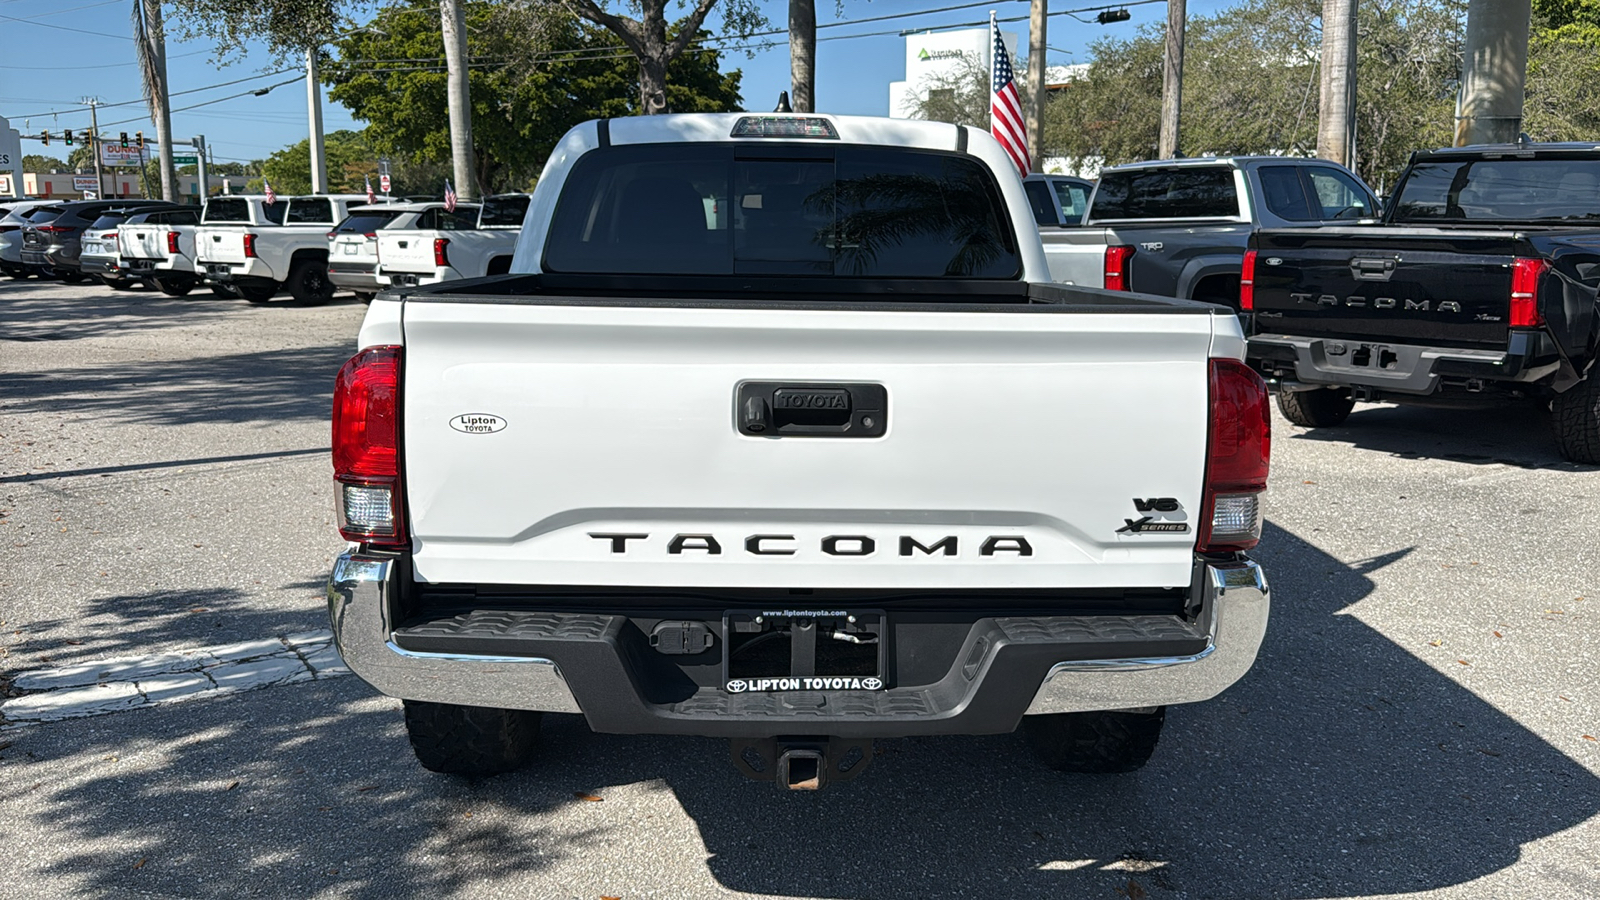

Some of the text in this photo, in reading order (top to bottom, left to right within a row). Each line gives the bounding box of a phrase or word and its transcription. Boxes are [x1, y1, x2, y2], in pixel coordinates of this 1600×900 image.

[1140, 241, 1163, 251] TRD
[1290, 293, 1461, 313] TACOMA
[781, 394, 846, 408] TOYOTA
[461, 416, 497, 426] Lipton
[1132, 497, 1179, 512] V6
[586, 532, 1033, 557] TACOMA
[762, 609, 847, 618] www.liptontoyota.com
[749, 677, 861, 691] LIPTON TOYOTA
